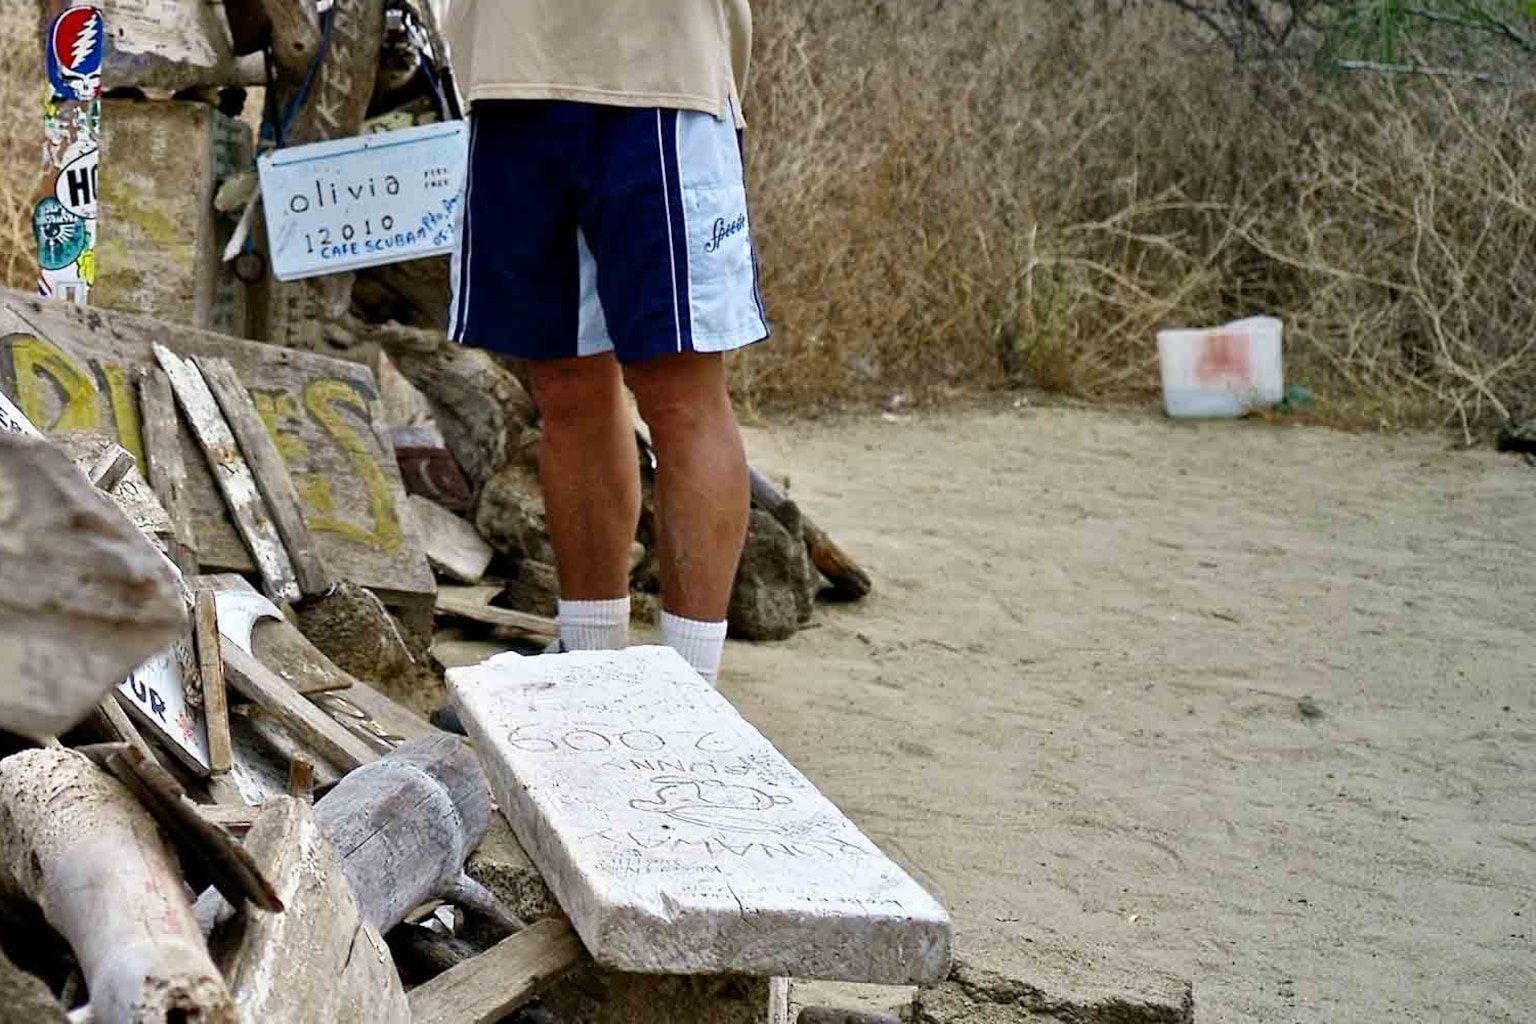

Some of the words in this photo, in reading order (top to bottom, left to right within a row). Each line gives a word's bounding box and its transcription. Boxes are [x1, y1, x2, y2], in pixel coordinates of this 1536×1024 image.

[290, 175, 400, 213] olivia
[321, 241, 359, 259] CAFE
[365, 233, 416, 252] SCUBA
